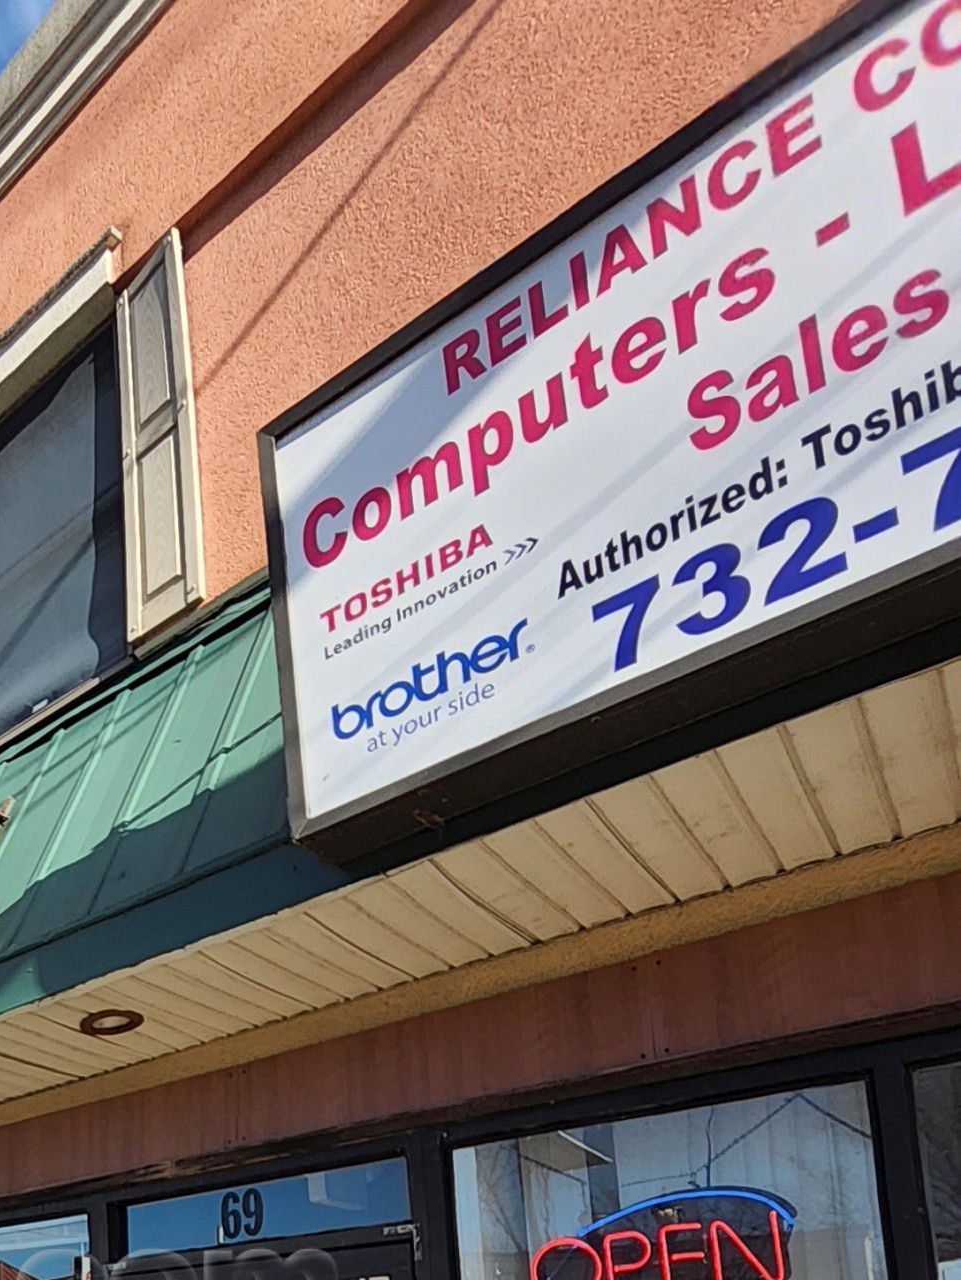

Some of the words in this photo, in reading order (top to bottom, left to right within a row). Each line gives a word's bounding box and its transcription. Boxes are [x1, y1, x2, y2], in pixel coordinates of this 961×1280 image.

[442, 93, 822, 396] RELIANCE
[302, 246, 777, 569] Computers
[686, 268, 950, 451] Sales
[319, 524, 494, 633] TOSHIBA
[558, 456, 788, 600] Authorized:
[591, 426, 961, 673] 732-7
[324, 616, 392, 660] Leading
[396, 559, 497, 623] Innovation
[331, 617, 529, 740] brother
[366, 731, 388, 753] at
[391, 706, 443, 747] your
[448, 682, 496, 717] side
[220, 1187, 264, 1239] 69
